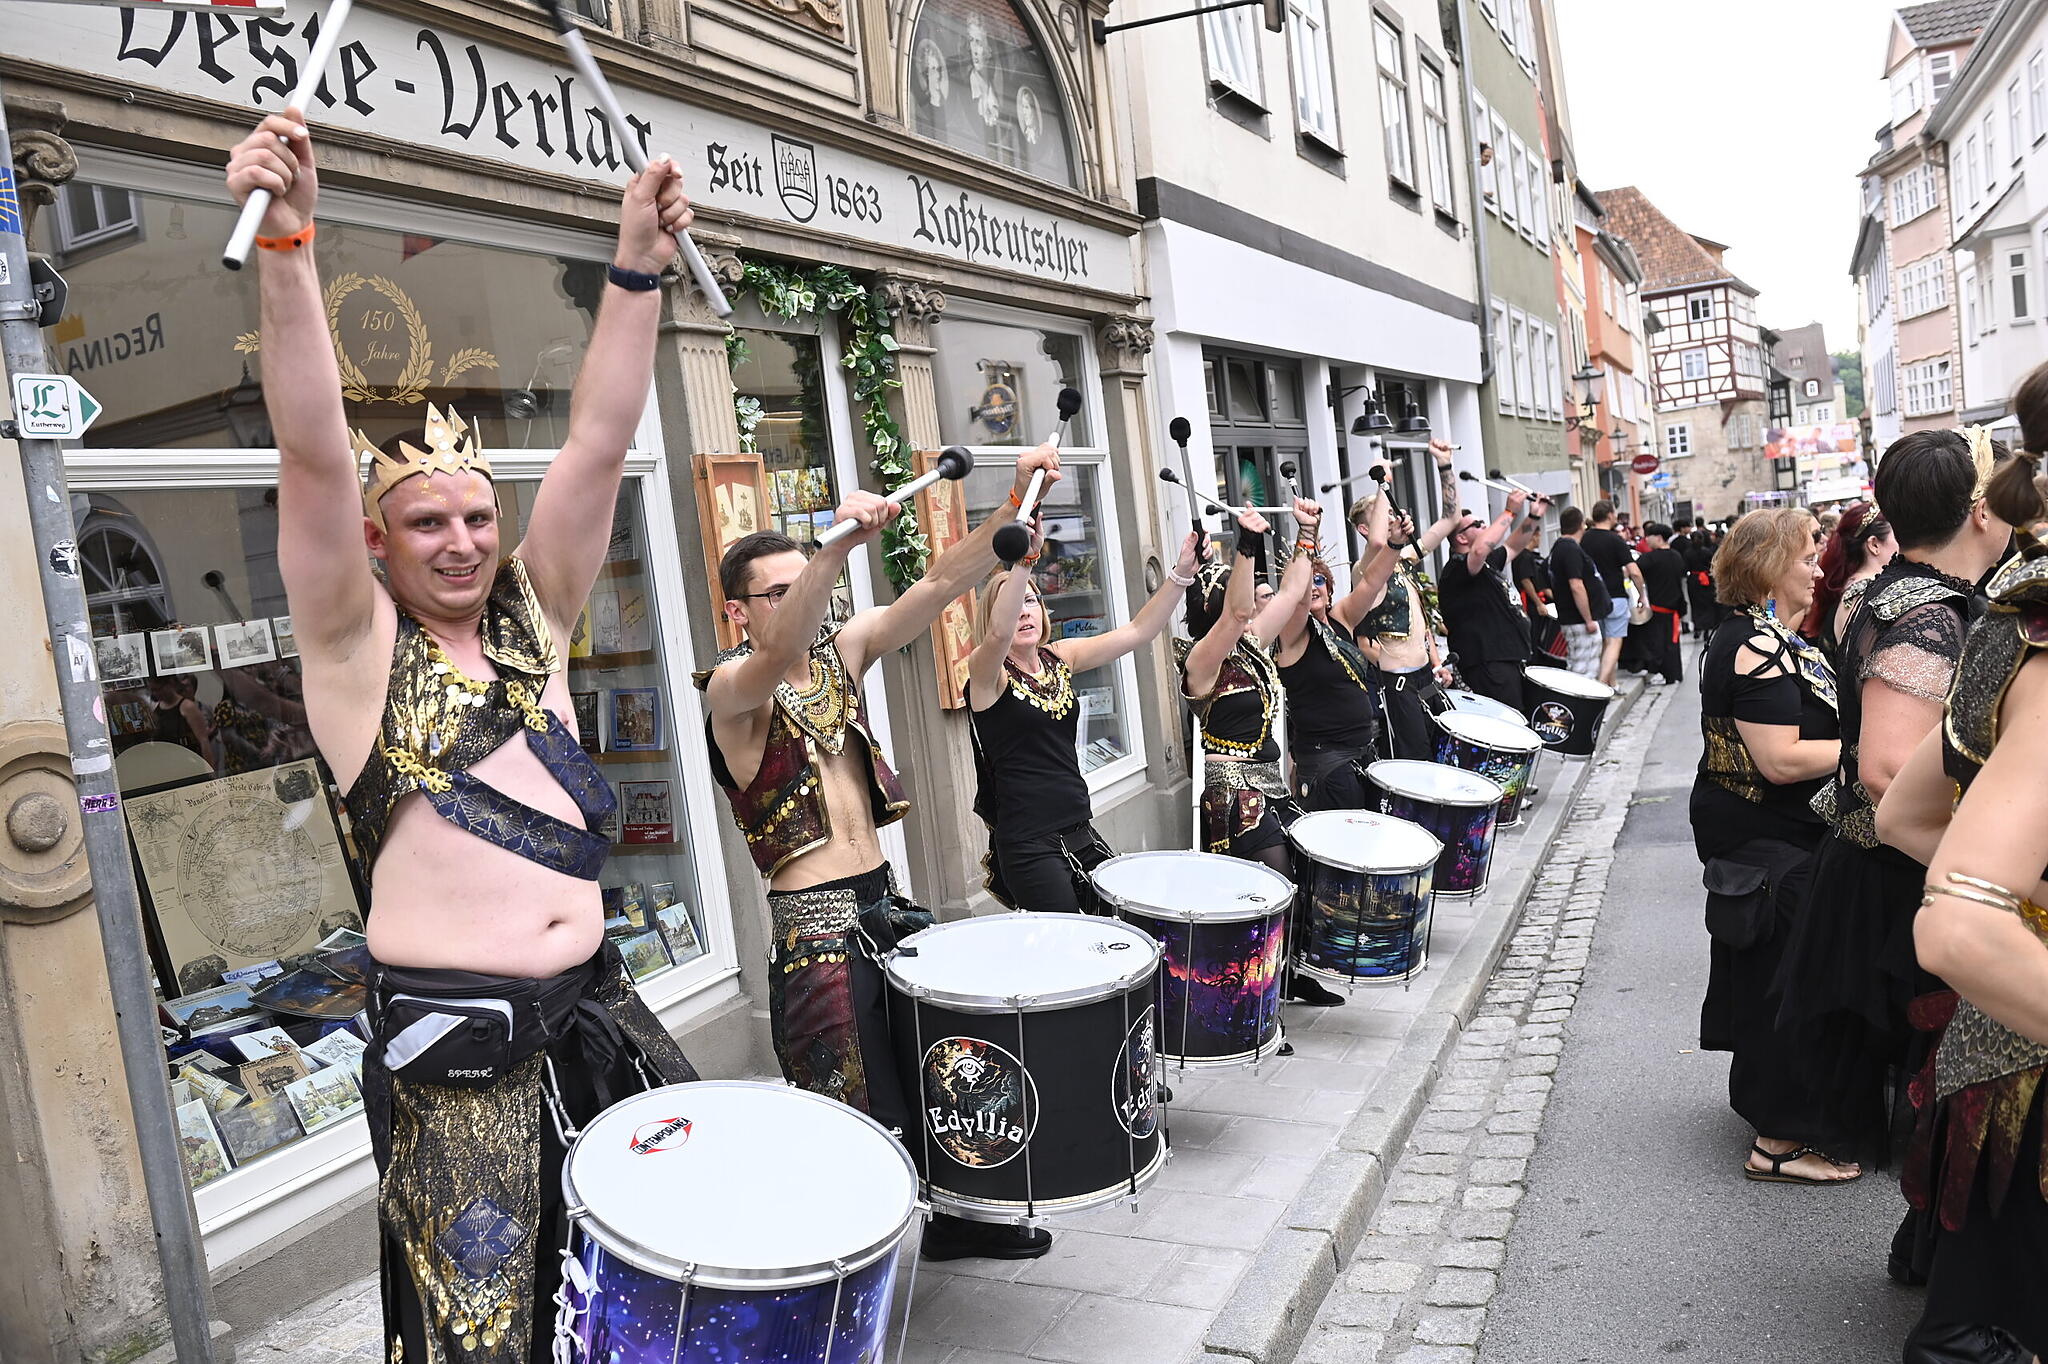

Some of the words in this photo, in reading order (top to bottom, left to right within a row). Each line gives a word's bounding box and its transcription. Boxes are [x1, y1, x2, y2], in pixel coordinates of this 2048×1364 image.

[707, 141, 763, 197] Seit
[825, 173, 882, 224] 1863
[907, 174, 1089, 281] Roßteutscher
[360, 309, 395, 331] 150
[361, 340, 400, 367] Jahre
[31, 421, 66, 429] Lutherweg
[928, 1107, 1024, 1143] Edyllia
